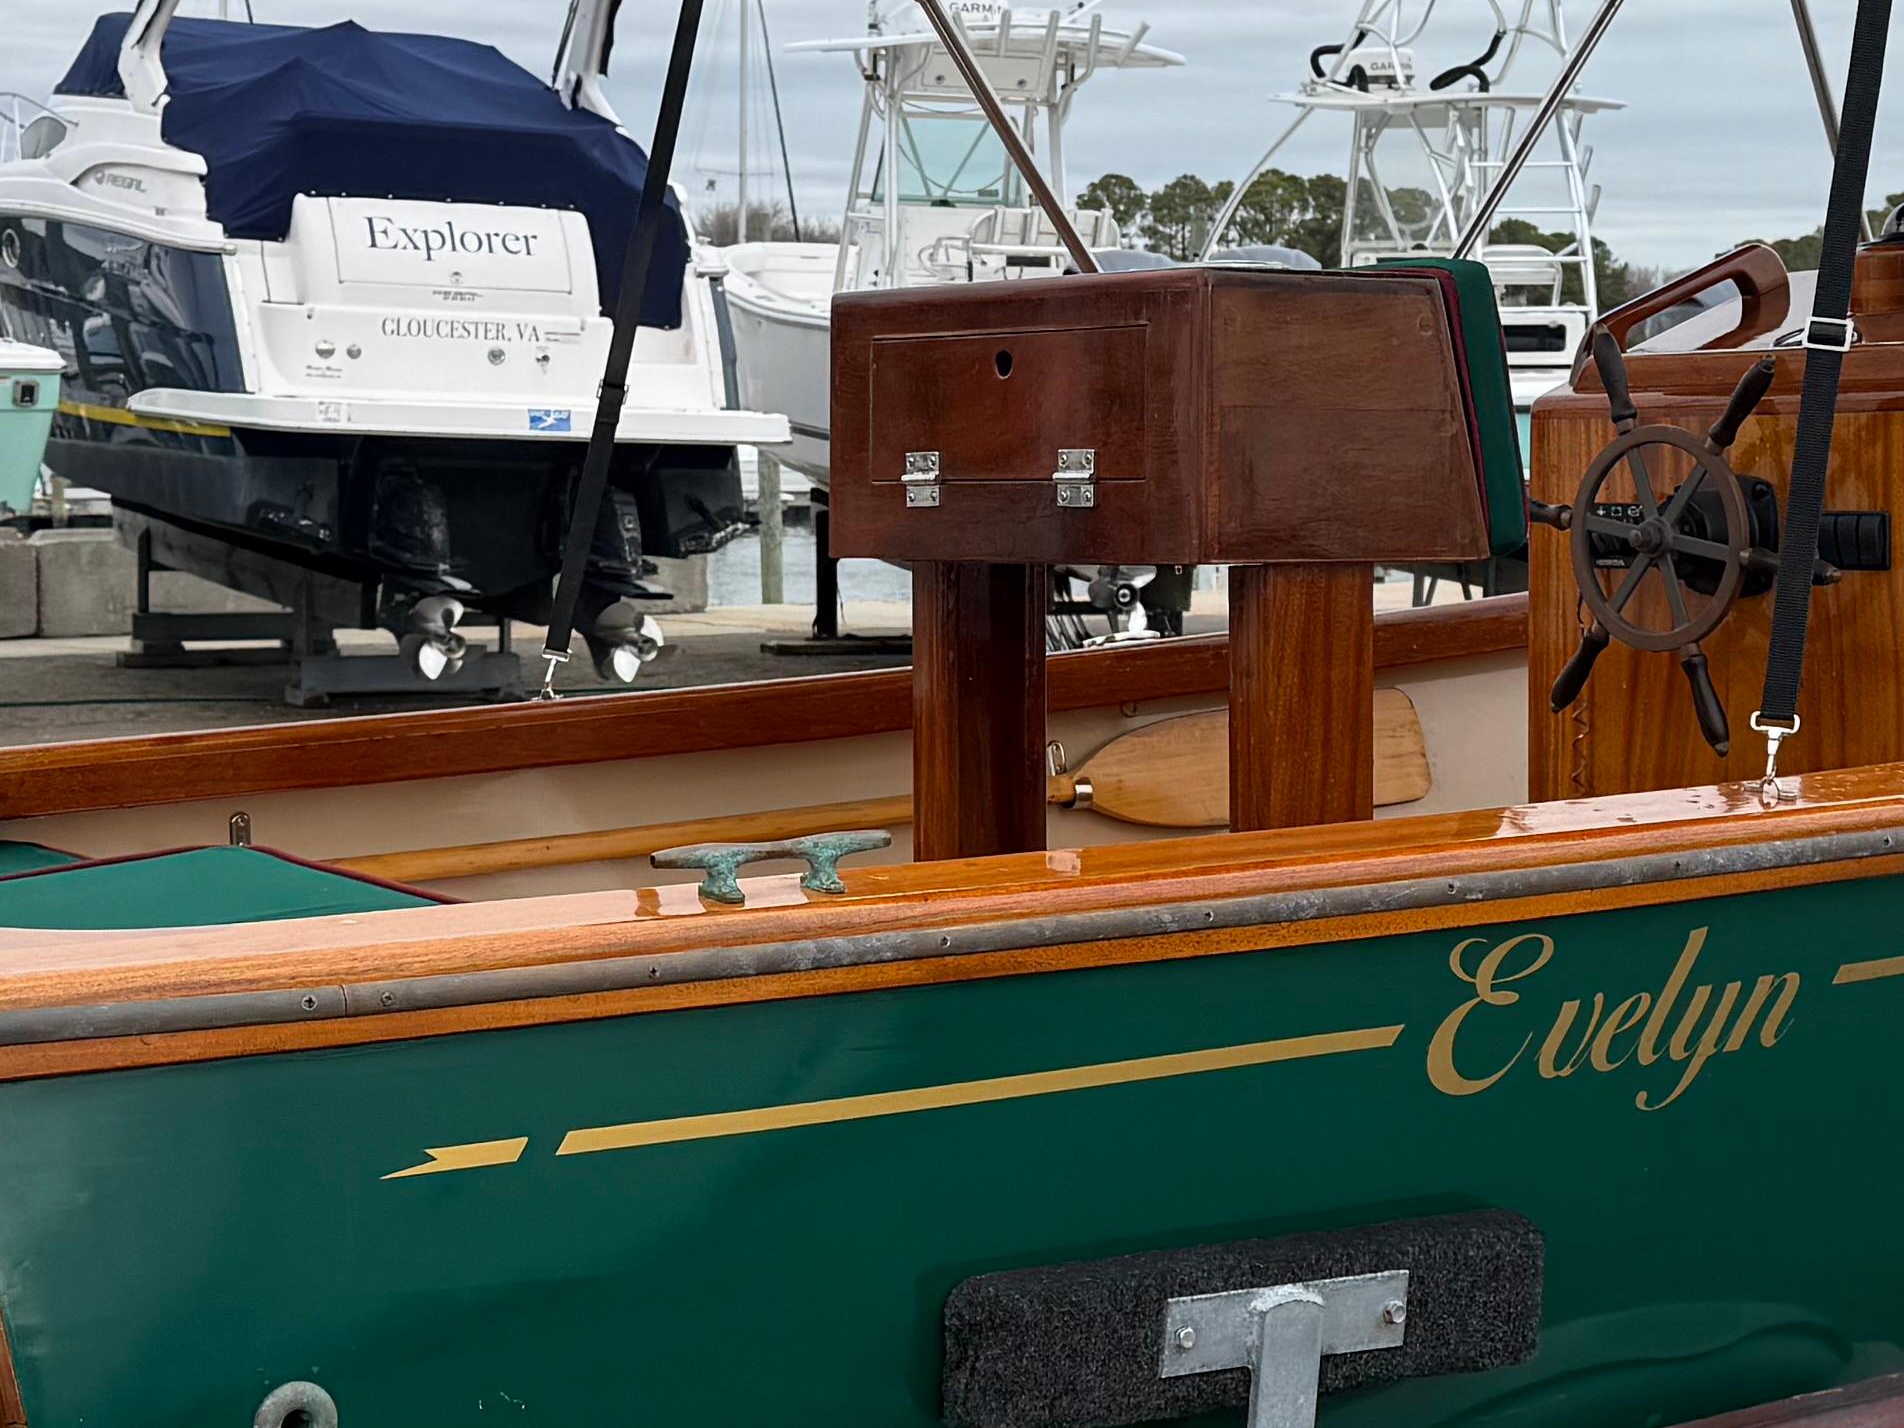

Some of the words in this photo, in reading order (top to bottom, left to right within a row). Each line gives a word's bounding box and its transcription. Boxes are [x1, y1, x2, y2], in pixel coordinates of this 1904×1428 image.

[949, 1, 1003, 14] GARM
[1370, 61, 1413, 71] GARIN
[105, 173, 147, 193] REGAL
[363, 215, 538, 262] Explorer
[380, 316, 512, 343] GLOUCESTER,
[516, 322, 540, 343] VA
[1426, 925, 1801, 1111] Evelyn
